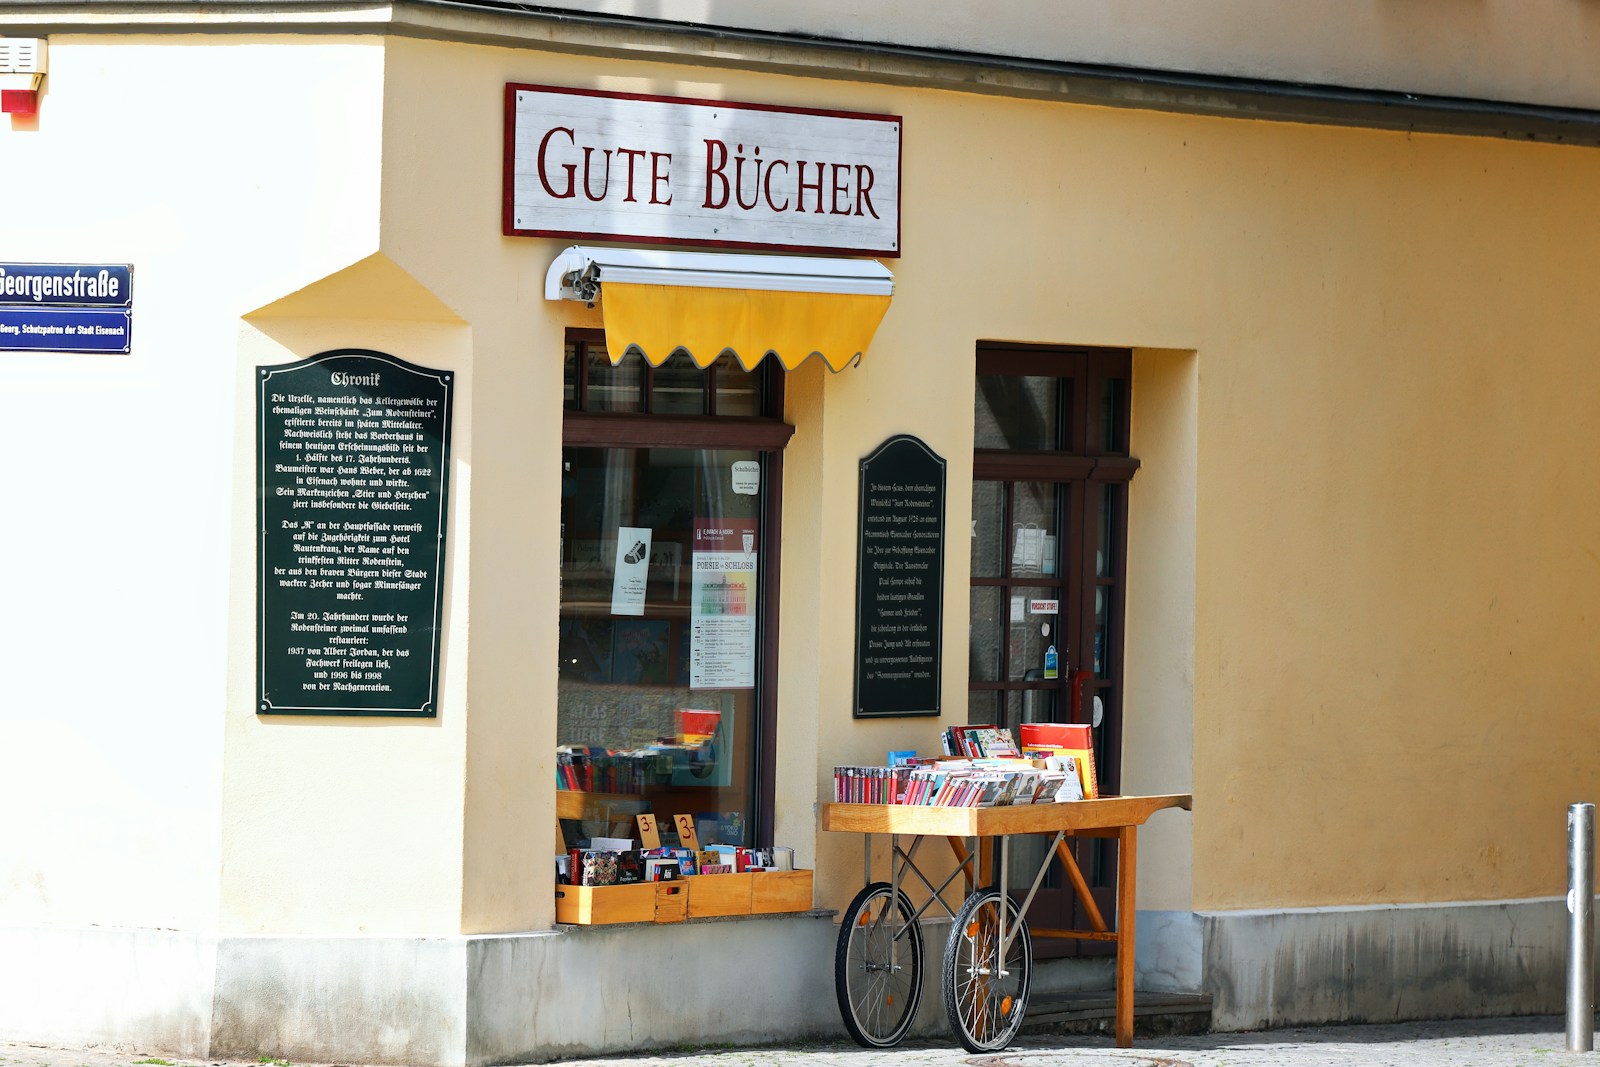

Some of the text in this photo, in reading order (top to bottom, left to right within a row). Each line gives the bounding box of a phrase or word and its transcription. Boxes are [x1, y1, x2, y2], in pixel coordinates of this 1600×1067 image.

[536, 125, 881, 220] GUTE BÜCHER
[22, 324, 64, 336] Schutzpatron
[64, 324, 76, 335] der
[77, 325, 94, 335] Stadt
[95, 326, 124, 336] Eisenach
[331, 372, 380, 387] Chronik
[271, 394, 438, 408] Die Urzelle, namentlich das Kellergewölbe der
[272, 406, 312, 417] ehemaligen
[318, 419, 342, 427] bereits
[344, 419, 354, 427] im
[381, 420, 424, 429] Mittelalter.
[354, 431, 368, 440] das
[370, 432, 414, 443] Vorderhaus
[416, 433, 424, 441] in
[305, 442, 335, 452] heutigen
[416, 444, 428, 453] der
[304, 454, 328, 464] Hälfte
[330, 454, 343, 462] des
[345, 454, 356, 463] 17.
[319, 466, 335, 474] war
[336, 466, 358, 476] Hans
[359, 466, 386, 477] Weber,
[388, 467, 400, 475] der
[402, 467, 412, 475] ab
[414, 468, 431, 476] 1622
[296, 477, 304, 485] in
[340, 478, 367, 488] wohnte
[369, 478, 383, 486] und
[385, 479, 410, 487] wirkte.
[276, 488, 295, 496] Sein
[297, 488, 349, 499] Markenzeichen
[377, 490, 392, 498] und
[293, 500, 309, 510] ziert
[358, 501, 369, 510] die
[281, 521, 298, 529] Das
[316, 522, 326, 530] an
[329, 522, 341, 530] der
[292, 533, 306, 543] auf
[307, 533, 319, 541] die
[372, 534, 387, 544] zum
[389, 534, 411, 545] Hotel
[293, 544, 409, 556] Rautenkranz, der Name auf den
[336, 557, 360, 565] Ritter
[696, 562, 720, 570] POESIE
[724, 562, 754, 570] SCHLOSS
[274, 567, 286, 575] der
[288, 568, 302, 576] aus
[304, 568, 317, 576] den
[320, 568, 345, 576] braven
[347, 569, 379, 579] Bürgern
[404, 570, 427, 578] Stadt
[279, 579, 307, 588] wackere
[309, 580, 334, 590] Zecher
[336, 580, 350, 588] und
[336, 591, 364, 602] machte.
[290, 612, 408, 623] Im 20. Jahrhundert wurde der
[340, 624, 369, 635] zweimal
[307, 647, 321, 655] von
[323, 647, 347, 656] Albert
[349, 648, 380, 658] Jordan,
[382, 648, 394, 656] der
[396, 648, 410, 656] das
[305, 659, 391, 670] Fachwerk freilegen ließ,
[314, 671, 382, 679] und 1996 bis 1998
[302, 682, 392, 693] von der Nachgeneration.
